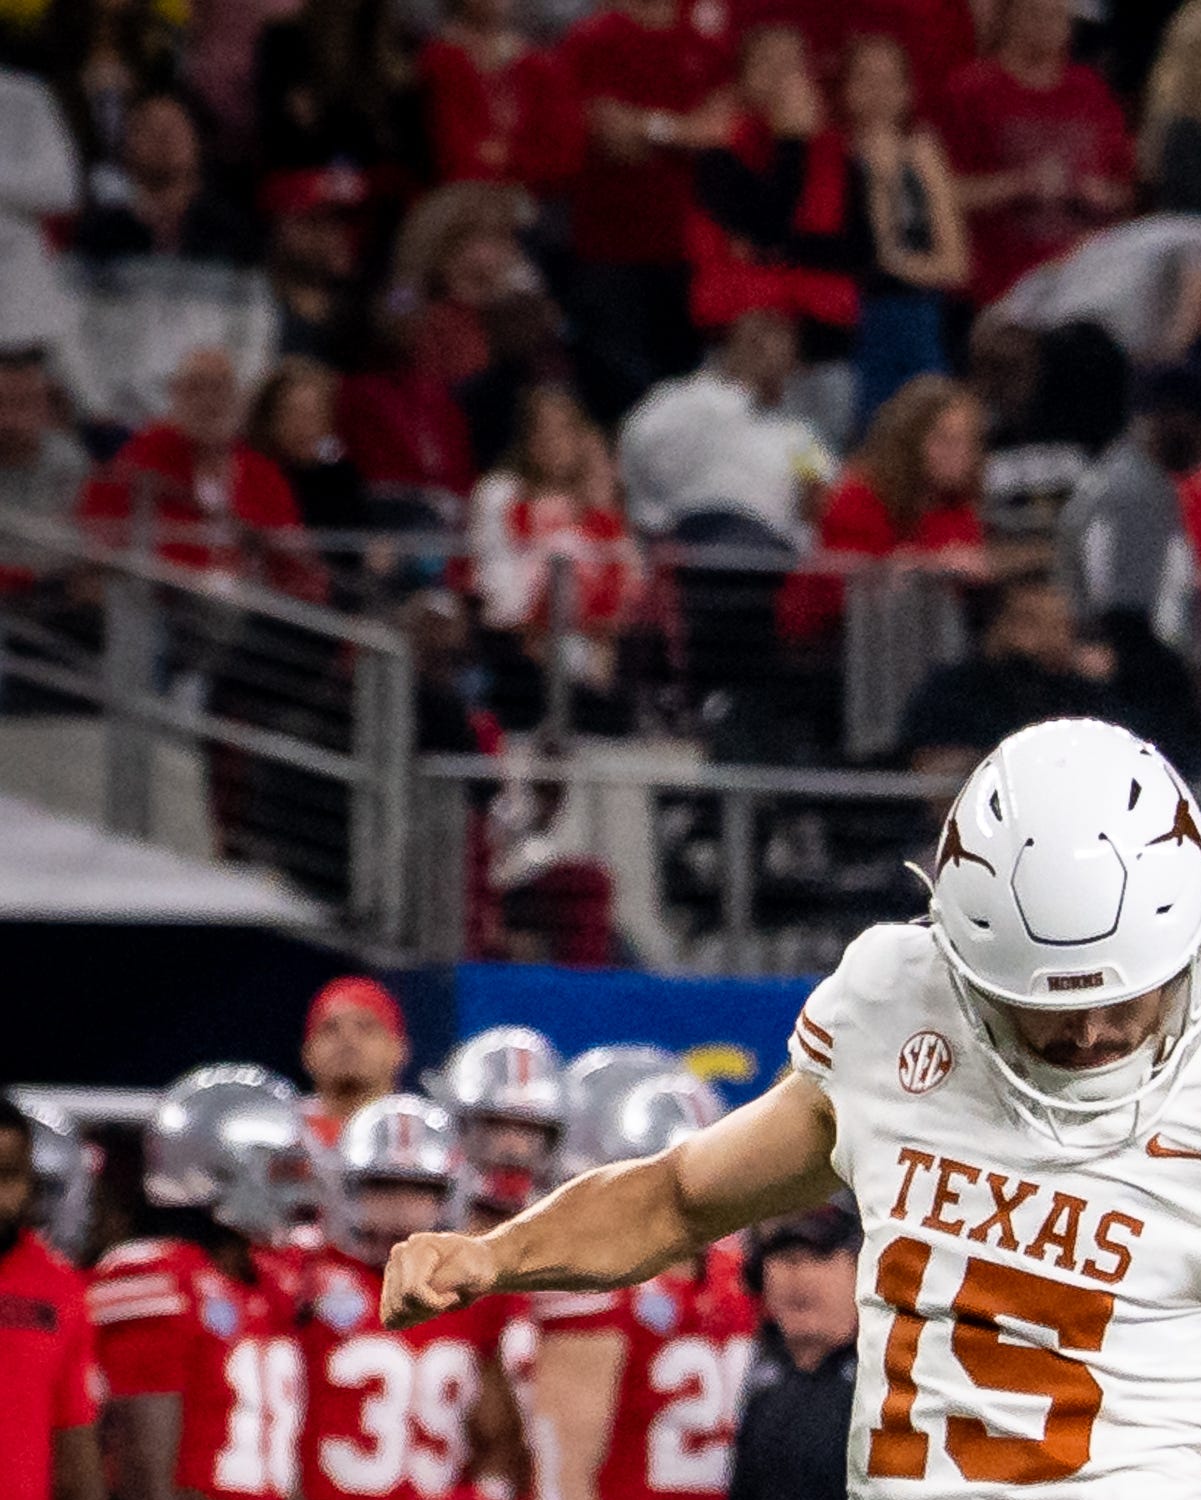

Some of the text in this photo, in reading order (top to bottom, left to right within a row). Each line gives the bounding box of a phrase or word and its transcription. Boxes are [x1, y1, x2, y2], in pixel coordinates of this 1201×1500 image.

[900, 1033, 950, 1090] SEC
[890, 1147, 1145, 1285] TEXAS
[867, 1235, 1116, 1485] 15
